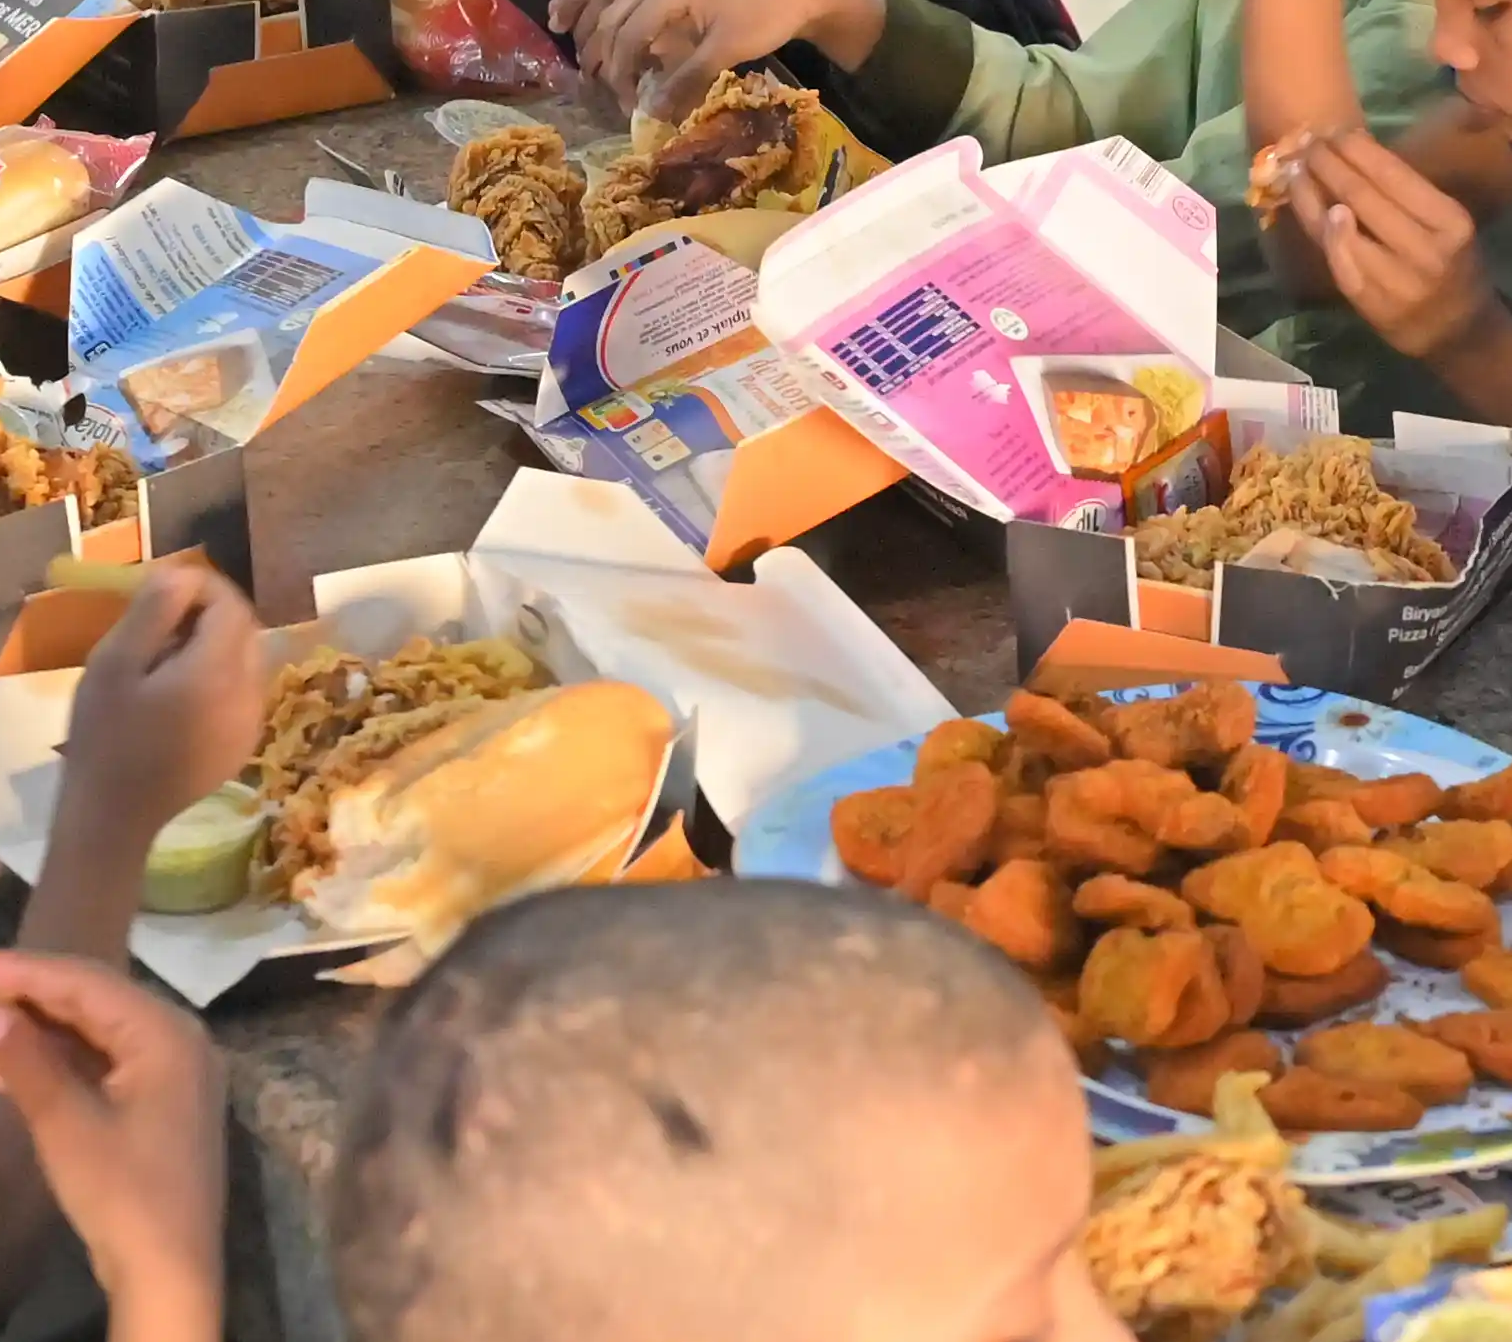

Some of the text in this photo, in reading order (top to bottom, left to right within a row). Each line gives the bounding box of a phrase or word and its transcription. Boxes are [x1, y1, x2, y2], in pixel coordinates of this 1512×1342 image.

[3, 6, 42, 38] MER
[696, 326, 710, 341] et
[74, 416, 121, 448] Tipia
[1388, 628, 1428, 644] Pizza
